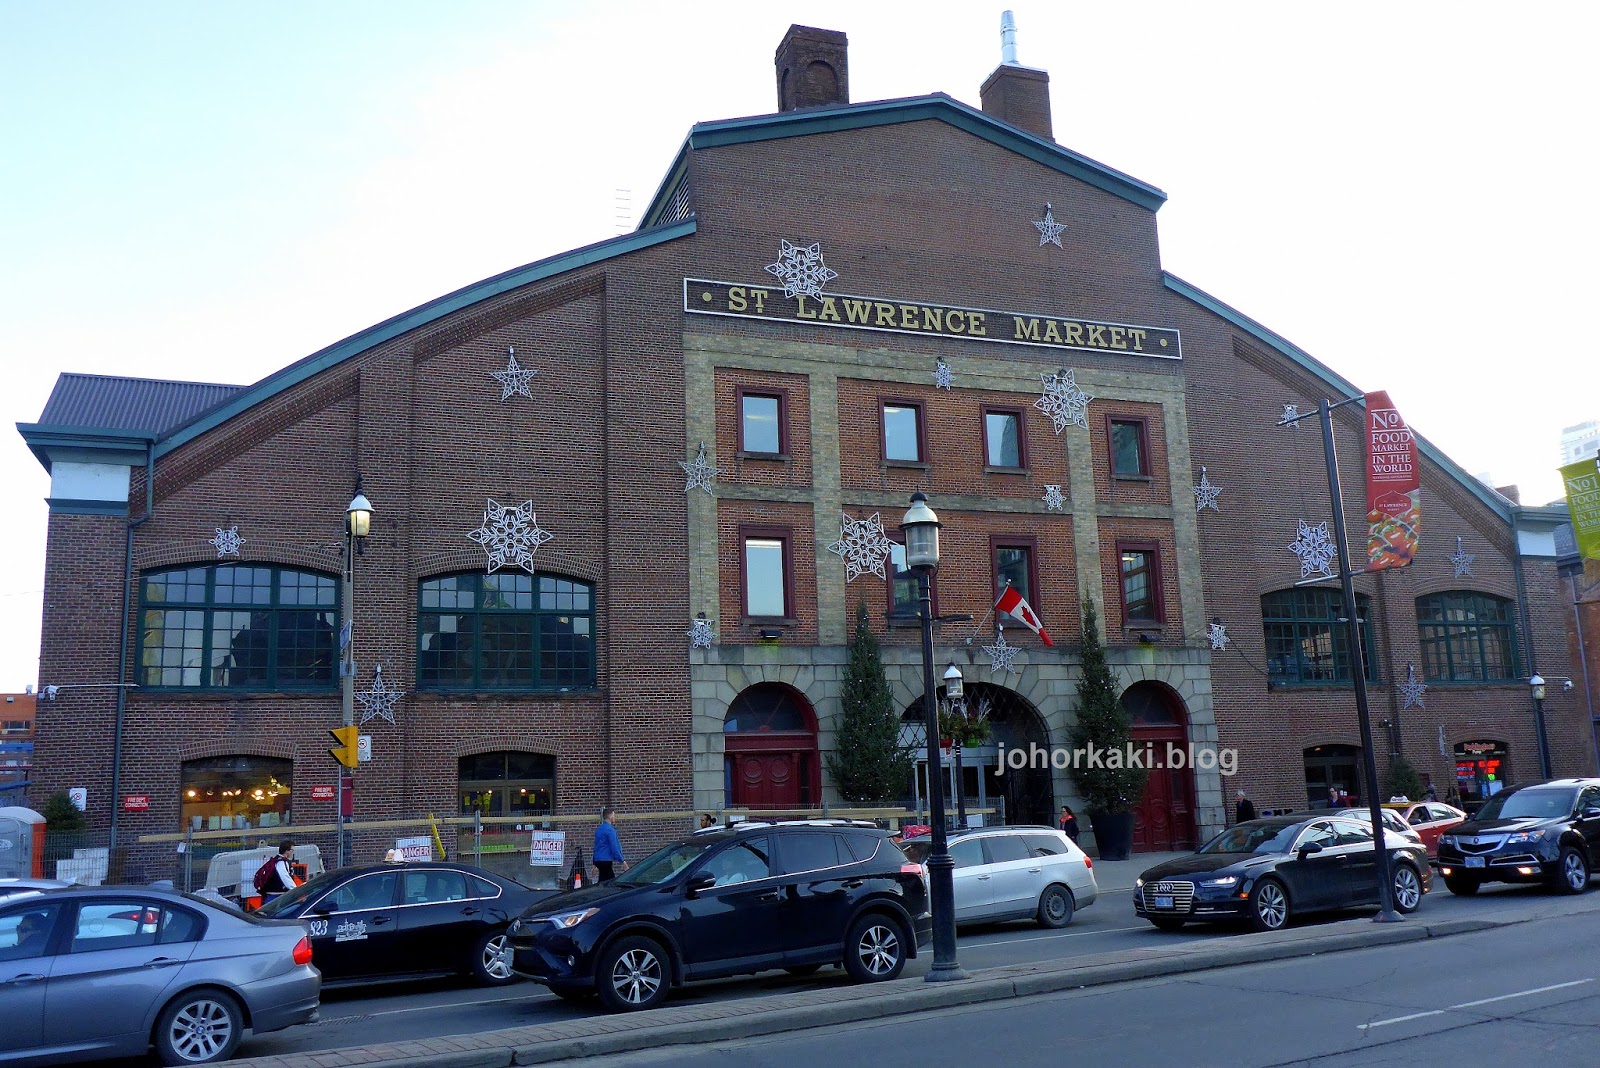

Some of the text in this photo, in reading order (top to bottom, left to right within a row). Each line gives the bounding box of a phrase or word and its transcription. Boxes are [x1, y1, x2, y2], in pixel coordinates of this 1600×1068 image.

[796, 295, 987, 336] LAWRENCE
[1013, 316, 1147, 351] MARKET
[1372, 432, 1410, 444] FOOD
[1372, 443, 1410, 452] MARKET
[1372, 454, 1411, 464] IN THE
[1373, 463, 1412, 473] WORLD
[1567, 476, 1599, 494] No1
[1574, 502, 1600, 512] MARKE
[1577, 510, 1600, 522] IN TH
[533, 840, 562, 850] DANGER
[310, 919, 328, 936] 823
